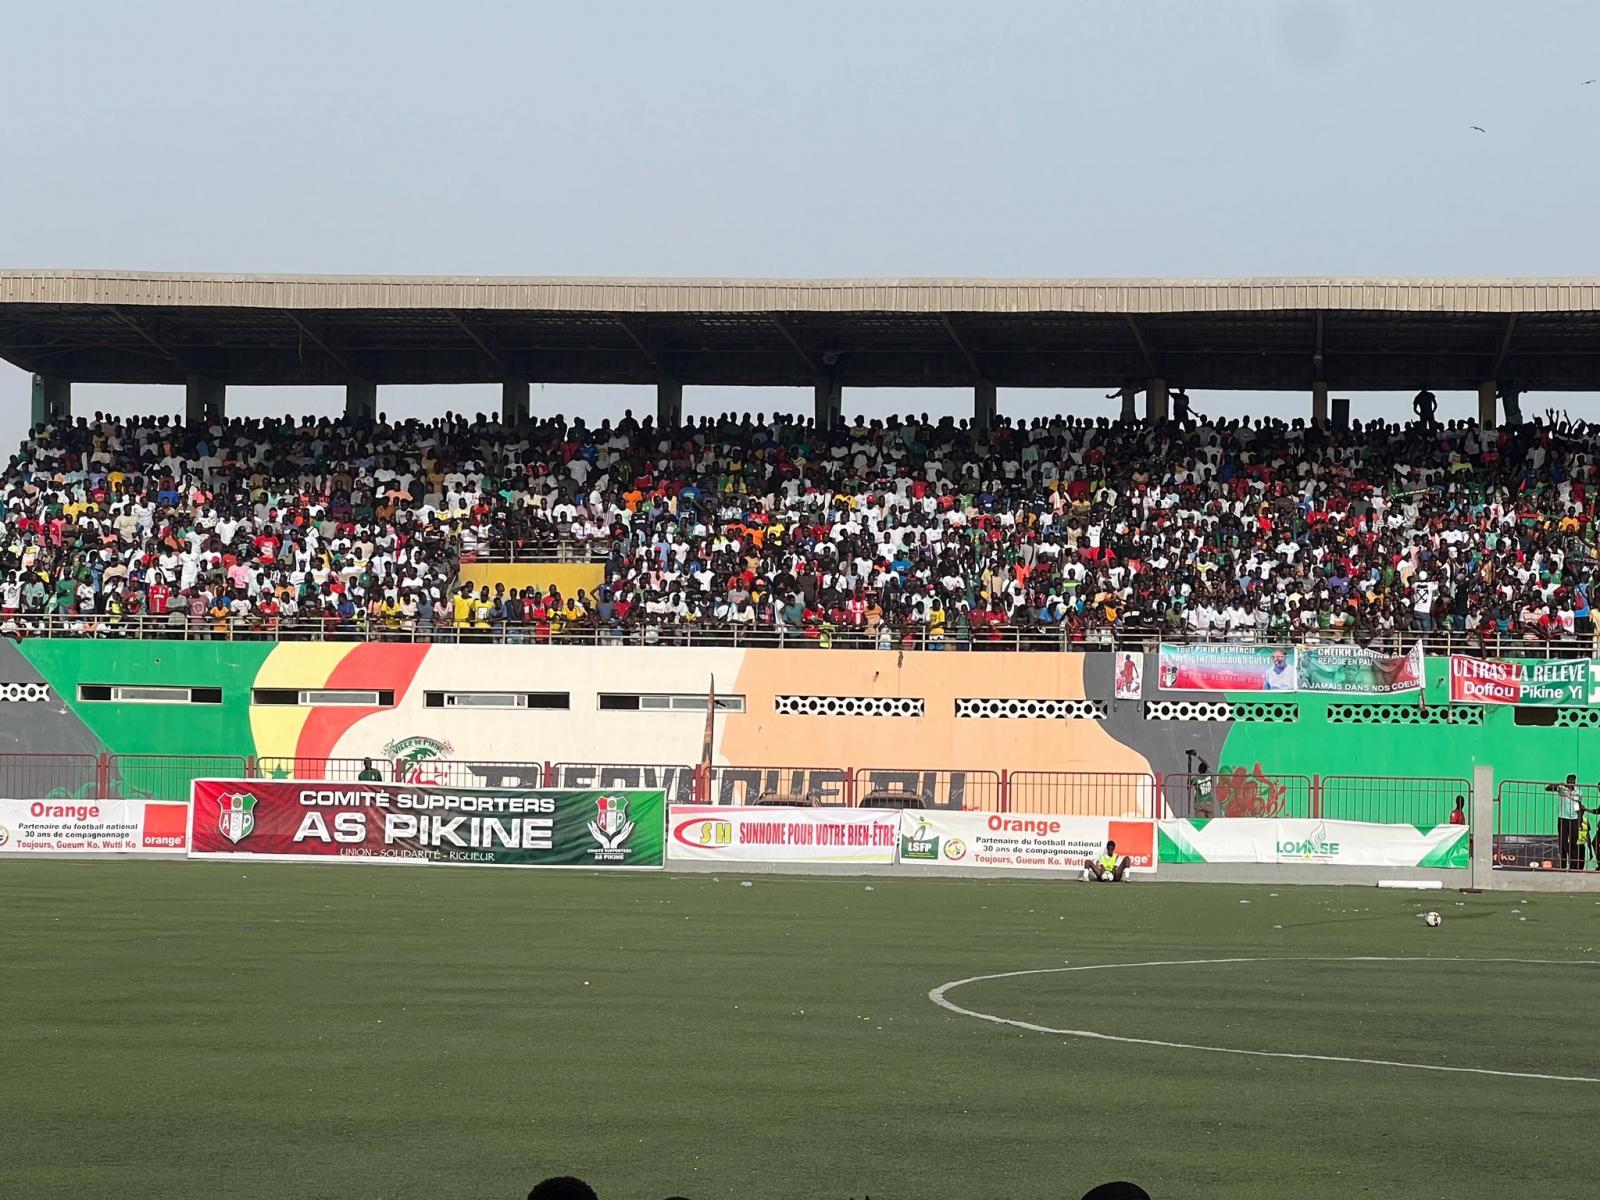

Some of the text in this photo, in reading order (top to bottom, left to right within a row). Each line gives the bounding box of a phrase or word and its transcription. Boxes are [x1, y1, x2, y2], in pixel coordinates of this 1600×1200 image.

[1318, 648, 1351, 658] CHEIKH
[1453, 659, 1507, 680] ULTRAS
[1511, 664, 1529, 681] LA
[1310, 682, 1342, 690] JAMAIS
[1371, 684, 1390, 692] NOS
[1463, 681, 1582, 699] Doffou Pikine Yi
[299, 789, 556, 813] COMITÉ SUPPORTERS
[30, 801, 100, 821] Orange
[221, 812, 252, 830] ASP
[987, 815, 1061, 836] Orange
[293, 811, 554, 849] AS PIKINE
[739, 820, 896, 848] SUNHOME POUR VOTRE BIEN-ÊTRE
[17, 840, 137, 850] Toujours, Gueum Ko. Wutti Ko
[144, 836, 182, 847] orange
[908, 841, 932, 852] LSFP
[975, 836, 1019, 845] Partenaire
[1034, 839, 1066, 847] football
[340, 847, 372, 857] UNION
[380, 849, 441, 860] SOLIDARITÉ
[449, 851, 496, 862] RIGUEUR
[1025, 847, 1094, 856] compagnonnage
[974, 854, 1014, 864] Toujours,
[1016, 856, 1046, 865] Gueum
[1064, 858, 1085, 866] Wutt
